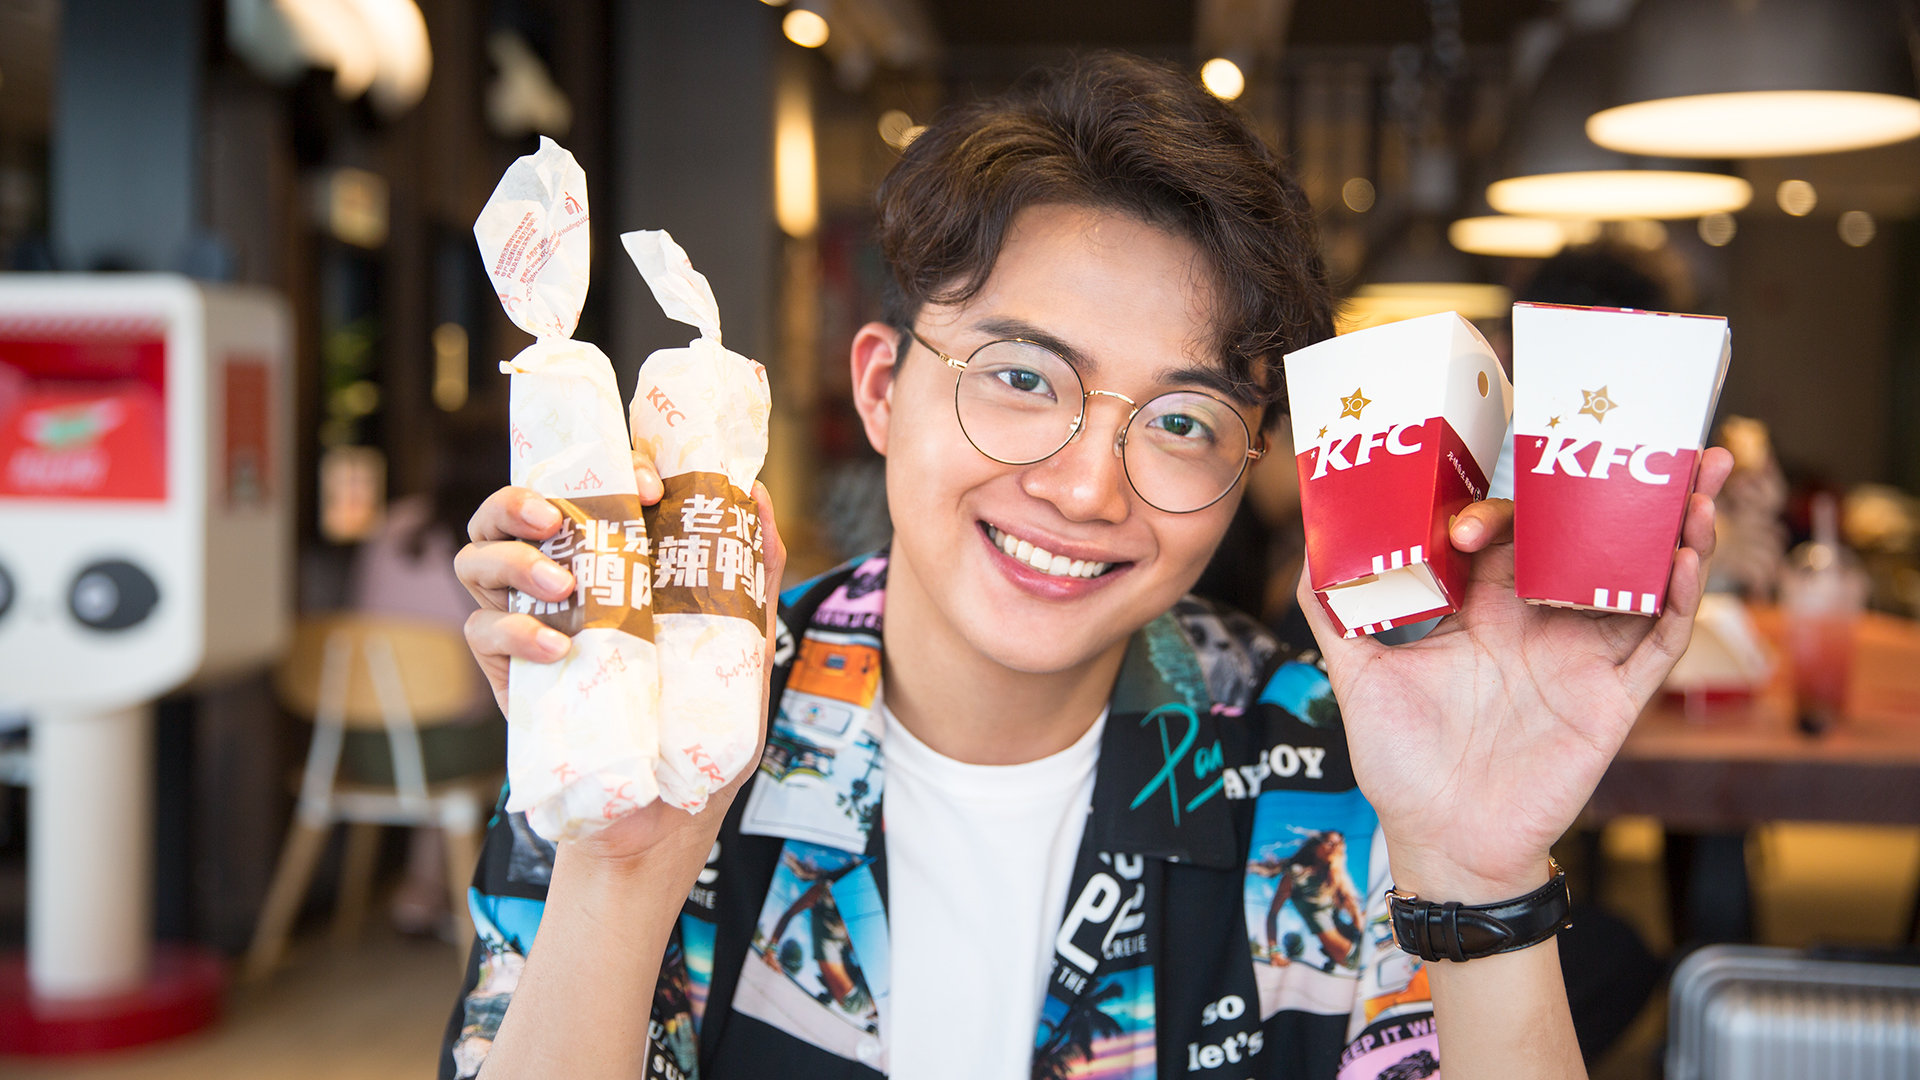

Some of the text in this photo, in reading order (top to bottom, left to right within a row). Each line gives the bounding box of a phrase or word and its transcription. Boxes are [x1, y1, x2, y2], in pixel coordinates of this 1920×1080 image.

[646, 385, 686, 427] KFC
[1343, 397, 1364, 413] 30
[1584, 392, 1609, 413] 30
[1309, 420, 1425, 481] KFC
[1531, 437, 1678, 485] KFC
[1057, 965, 1088, 996] THE
[1201, 994, 1246, 1027] so
[1187, 1030, 1264, 1072] let's
[1380, 1025, 1402, 1046] IT
